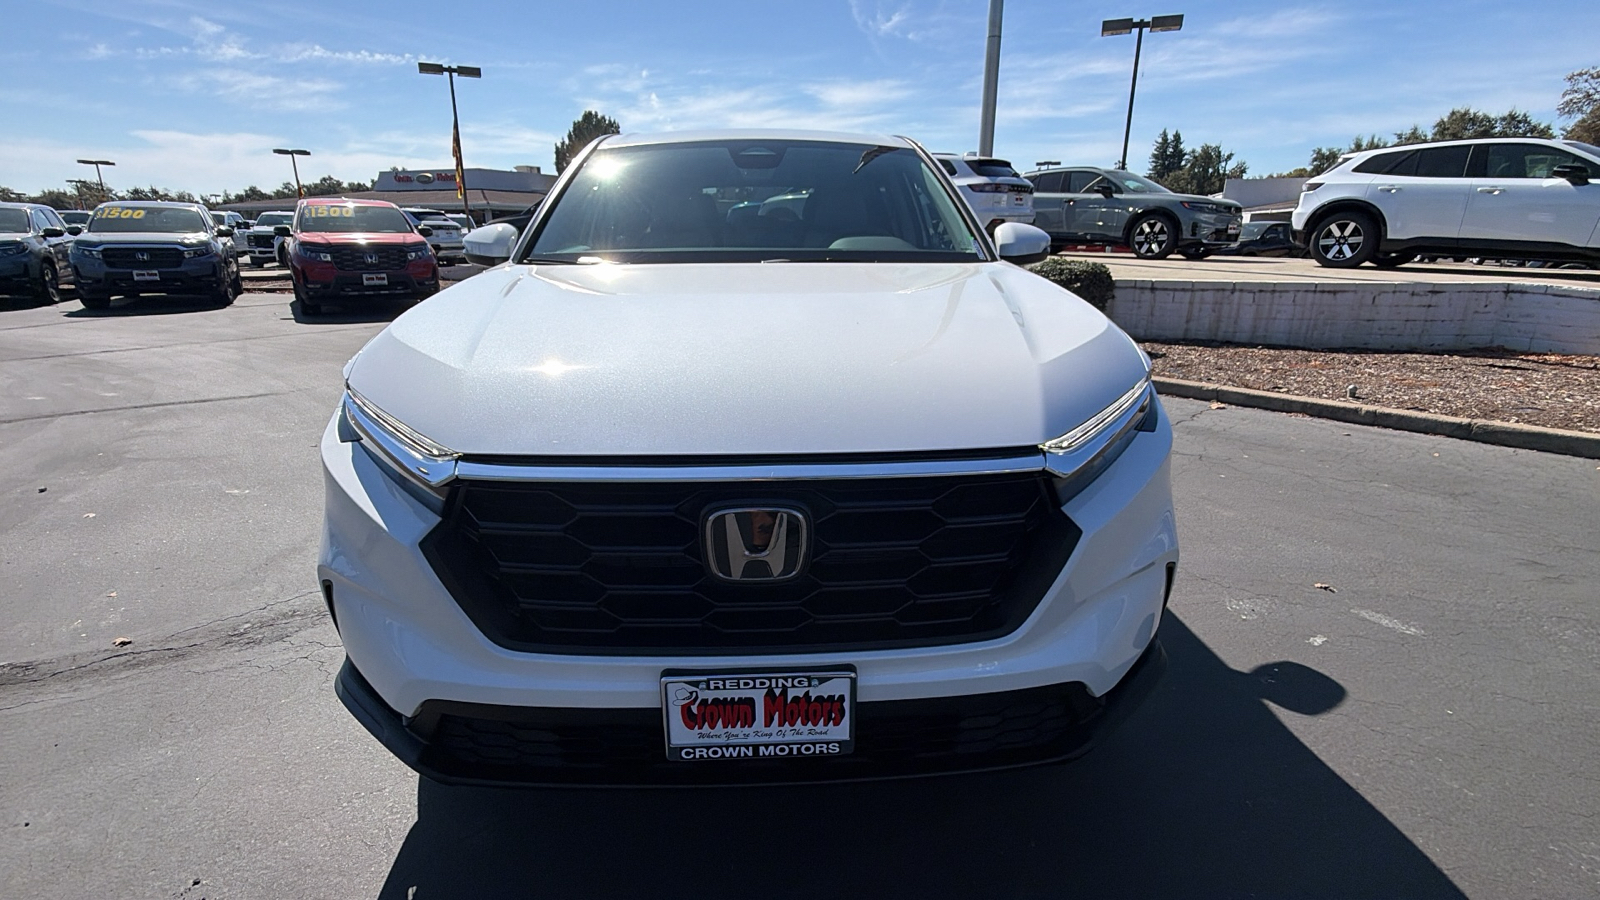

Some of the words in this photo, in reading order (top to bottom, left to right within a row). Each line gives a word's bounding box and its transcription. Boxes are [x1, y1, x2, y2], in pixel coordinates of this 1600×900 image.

[304, 206, 353, 218] $1500
[709, 677, 809, 691] REDDING
[680, 691, 757, 731] Crown
[763, 687, 846, 729] Motors
[697, 731, 722, 739] Where
[723, 730, 751, 742] You're
[752, 729, 773, 740] King
[775, 729, 787, 738] Of
[789, 728, 804, 736] The
[806, 728, 830, 736] Road
[681, 746, 754, 759] CROWN
[759, 742, 841, 757] MOTORS
